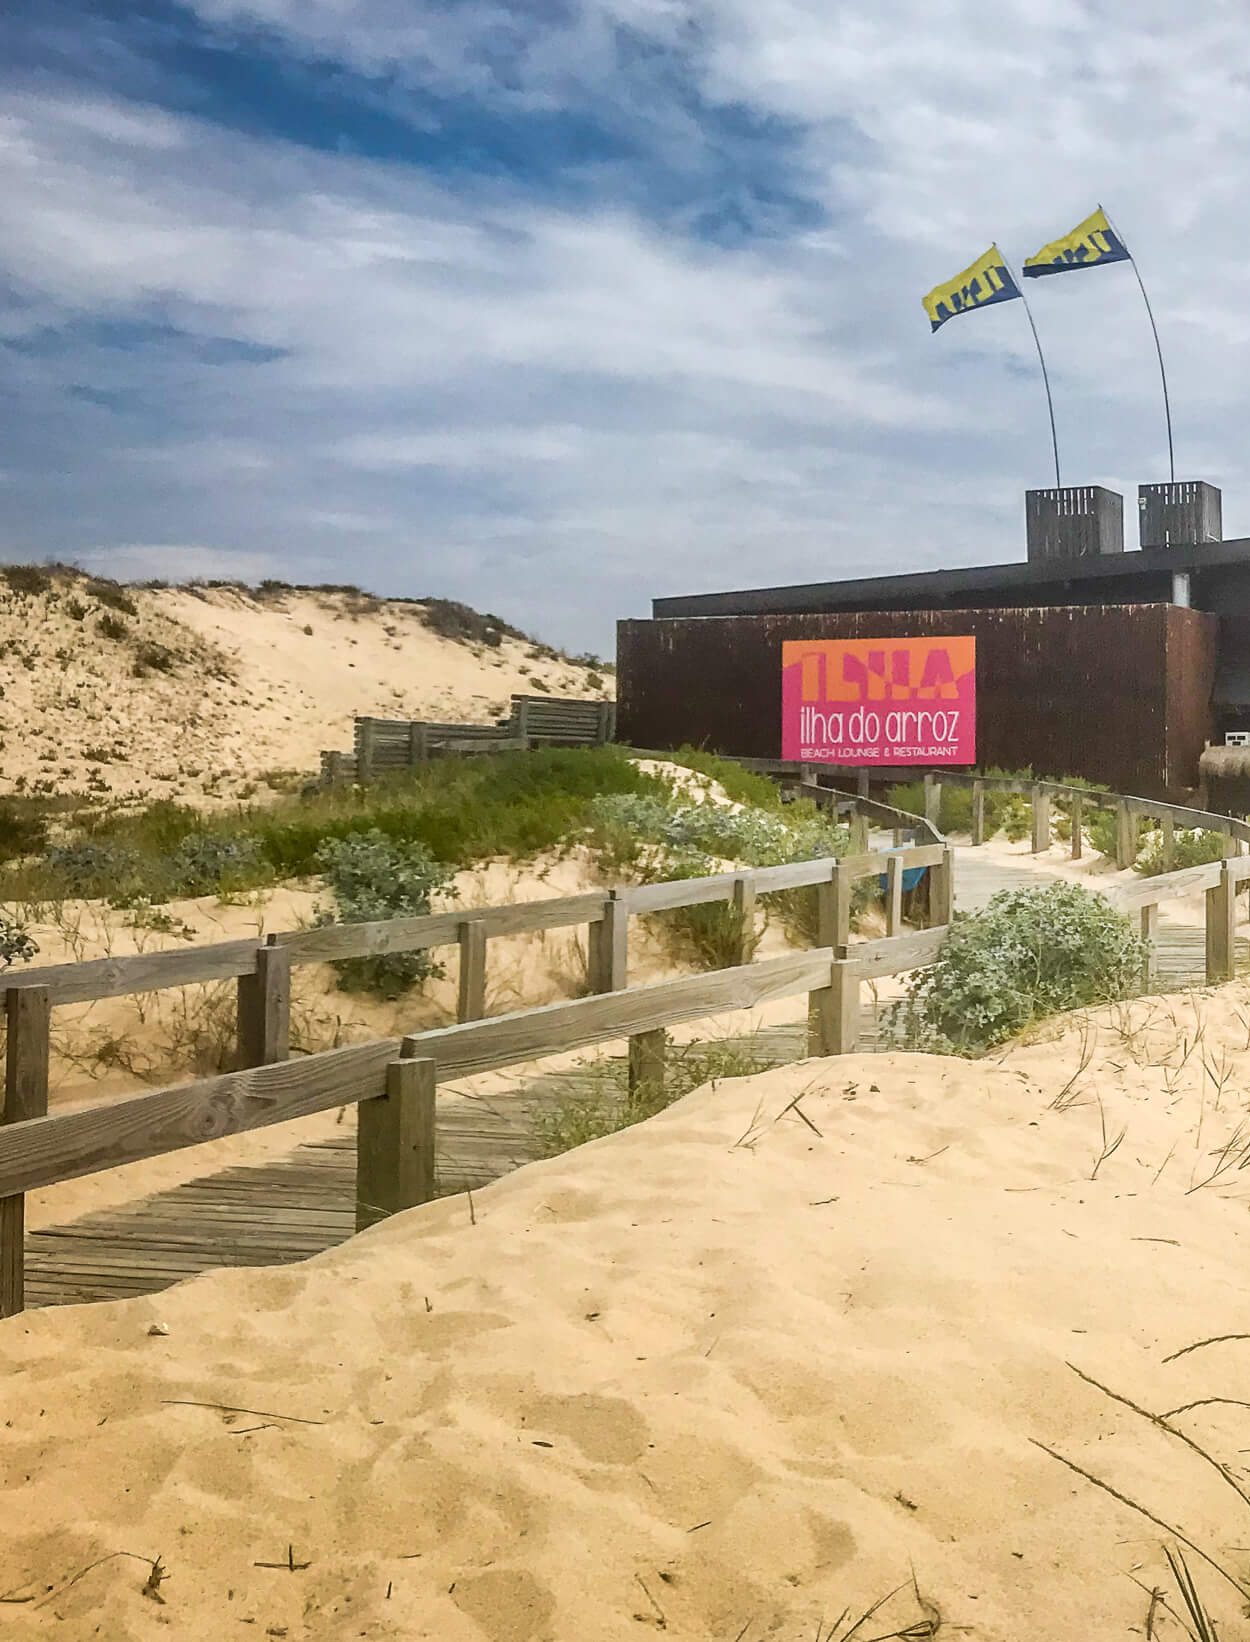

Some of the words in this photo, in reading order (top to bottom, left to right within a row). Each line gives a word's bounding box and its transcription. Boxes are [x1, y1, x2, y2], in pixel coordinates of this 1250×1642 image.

[801, 649, 960, 702] ILHA
[801, 706, 843, 744] ilha
[848, 705, 880, 744] do
[885, 711, 960, 744] arroz
[800, 748, 836, 759] BEACH
[838, 747, 880, 758] LOUNGE
[884, 747, 890, 757] &
[893, 746, 959, 757] RESTAURANT
